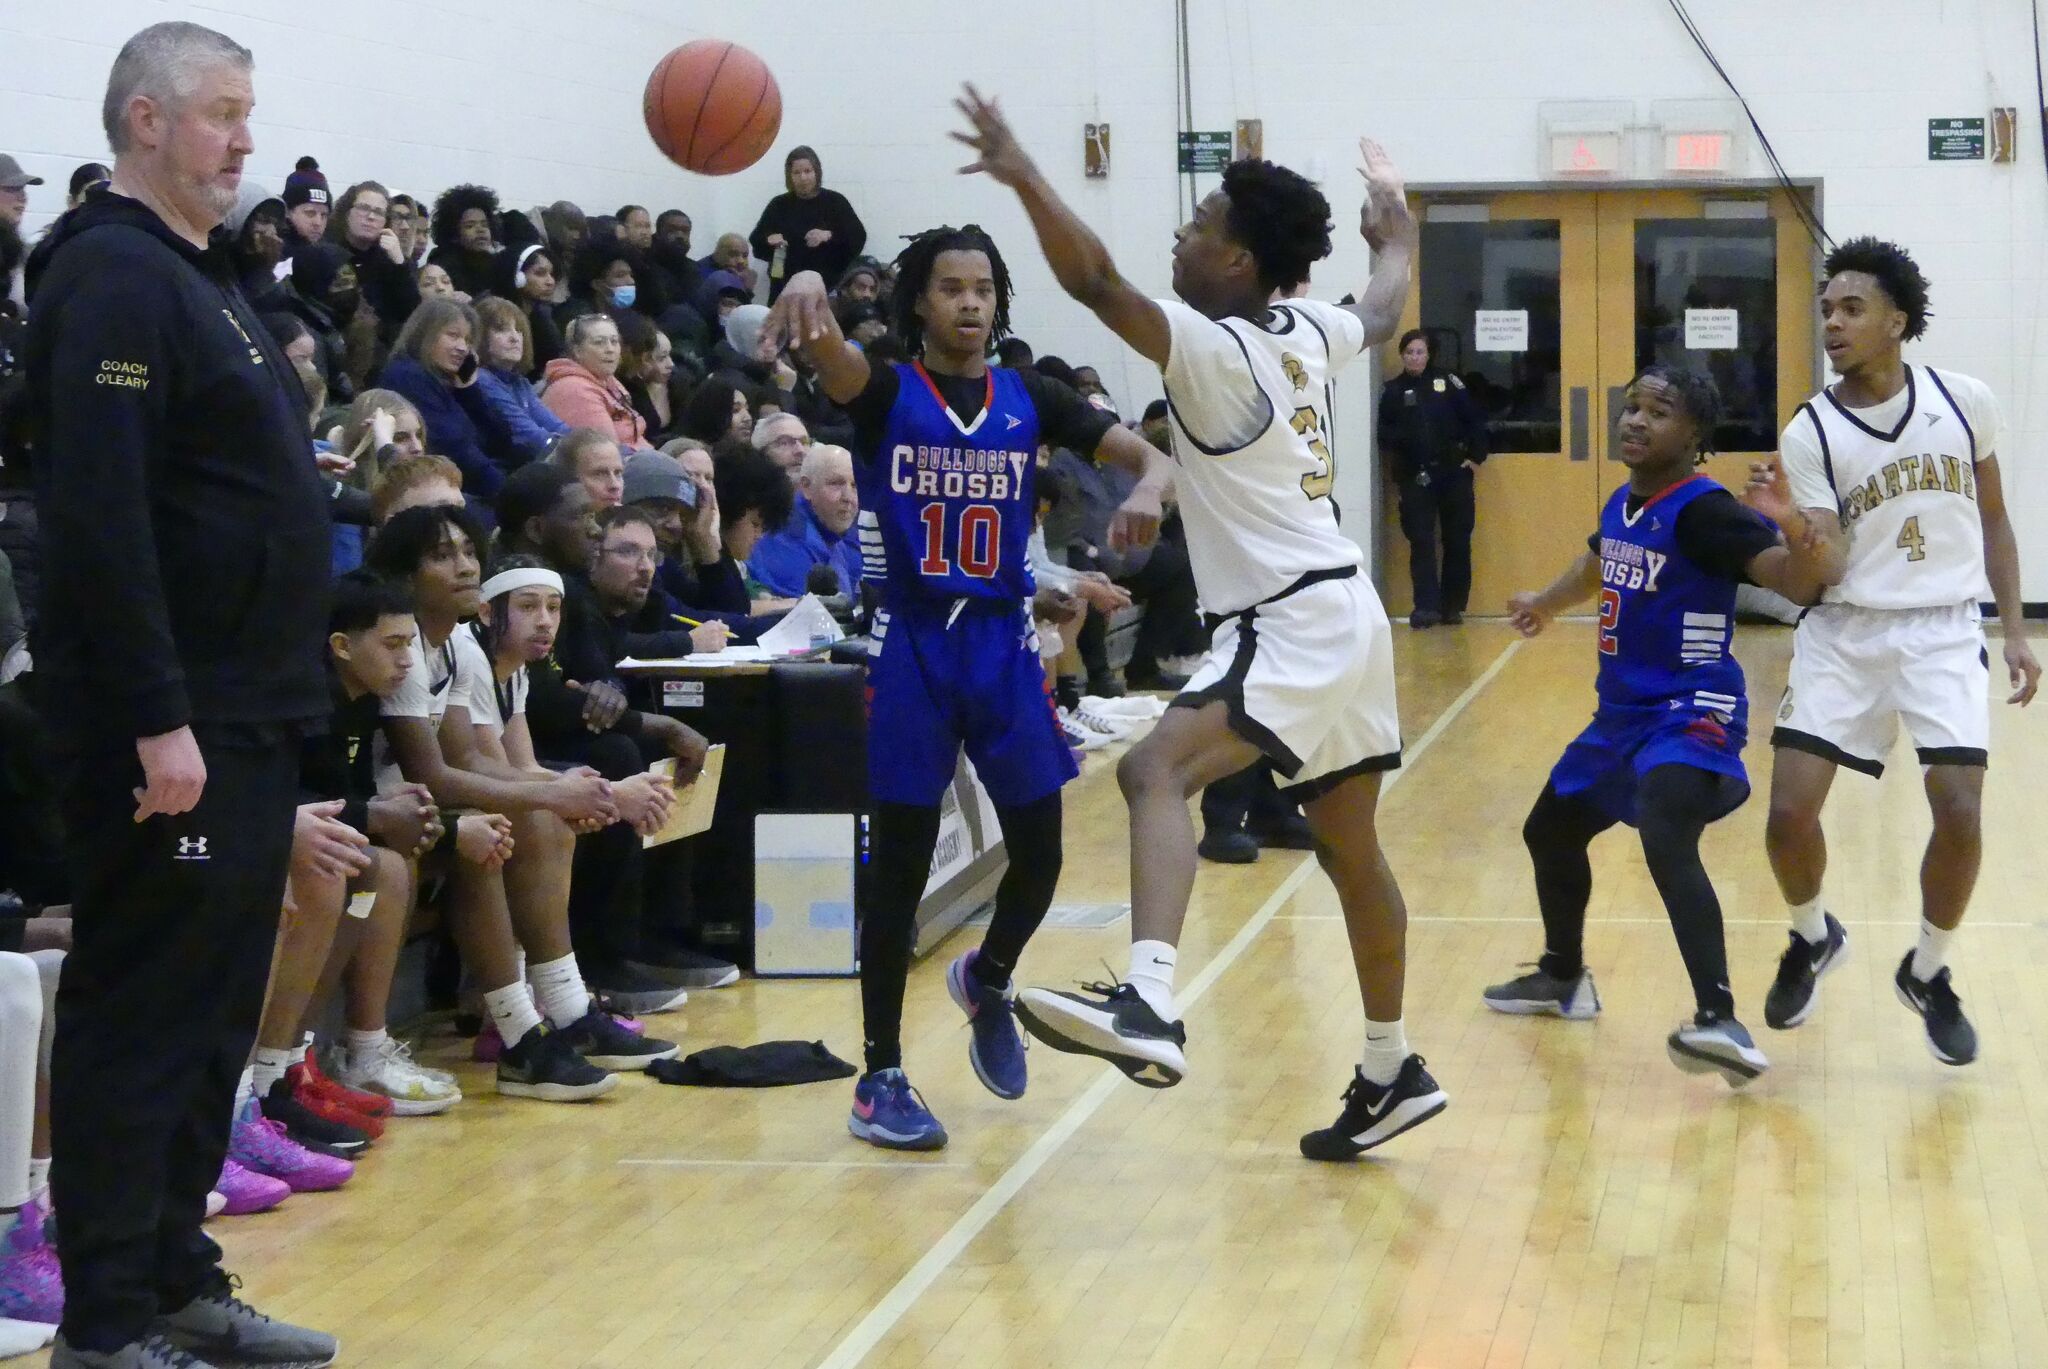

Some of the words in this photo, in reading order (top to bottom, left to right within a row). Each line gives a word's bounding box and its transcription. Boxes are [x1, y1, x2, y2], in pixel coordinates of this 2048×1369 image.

[1198, 134, 1211, 142] NO
[1931, 128, 1983, 137] TRESPASSING
[1950, 120, 1963, 128] NO
[1677, 134, 1722, 168] EXIT
[96, 373, 150, 390] O'LEARY
[101, 360, 148, 376] COACH
[891, 444, 1028, 500] CROSBY
[916, 446, 1008, 473] BULLDOGS
[920, 502, 1001, 579] 10
[1896, 515, 1925, 562] 4
[1600, 549, 1667, 592] OSBY
[1600, 587, 1621, 656] 2
